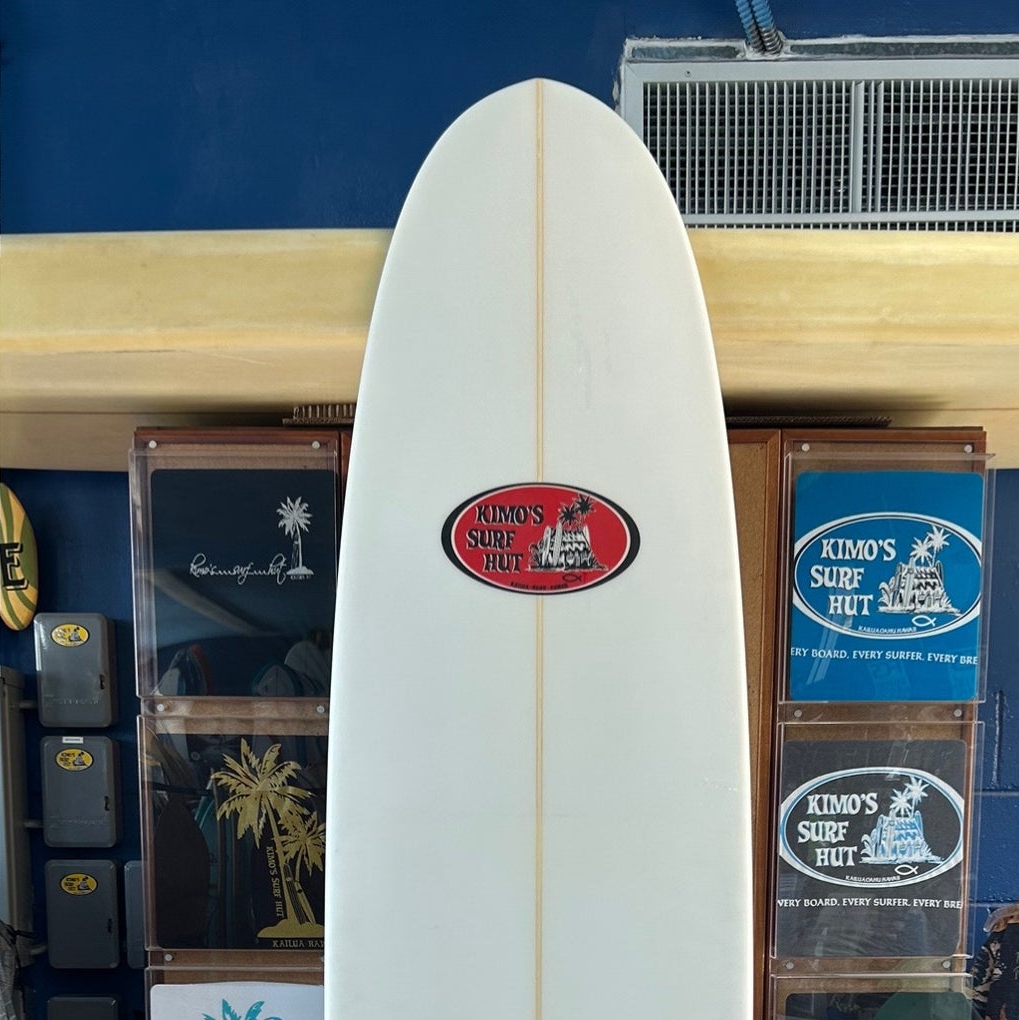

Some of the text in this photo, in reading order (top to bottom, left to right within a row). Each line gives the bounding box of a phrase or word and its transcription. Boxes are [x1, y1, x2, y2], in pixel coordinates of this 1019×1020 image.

[475, 505, 544, 526] KIMO'S
[466, 528, 516, 550] SURF
[821, 539, 896, 561] KIMO'S
[482, 553, 523, 573] HUT
[810, 565, 864, 590] SURF
[829, 595, 873, 616] HUT
[812, 649, 849, 658] BOARD.
[853, 651, 882, 659] EVERY
[885, 652, 924, 660] SURFER.
[928, 653, 957, 662] EVERY
[806, 793, 879, 815] KIMO'S
[797, 821, 849, 843] SURF
[815, 846, 857, 867] HUT
[266, 846, 284, 917] KIMO'S SURF HUT
[804, 899, 840, 907] BOARD.
[843, 898, 871, 906] EVERY
[873, 899, 911, 907] SURFER.
[913, 900, 941, 908] EVERY
[273, 940, 304, 948] KAILUA
